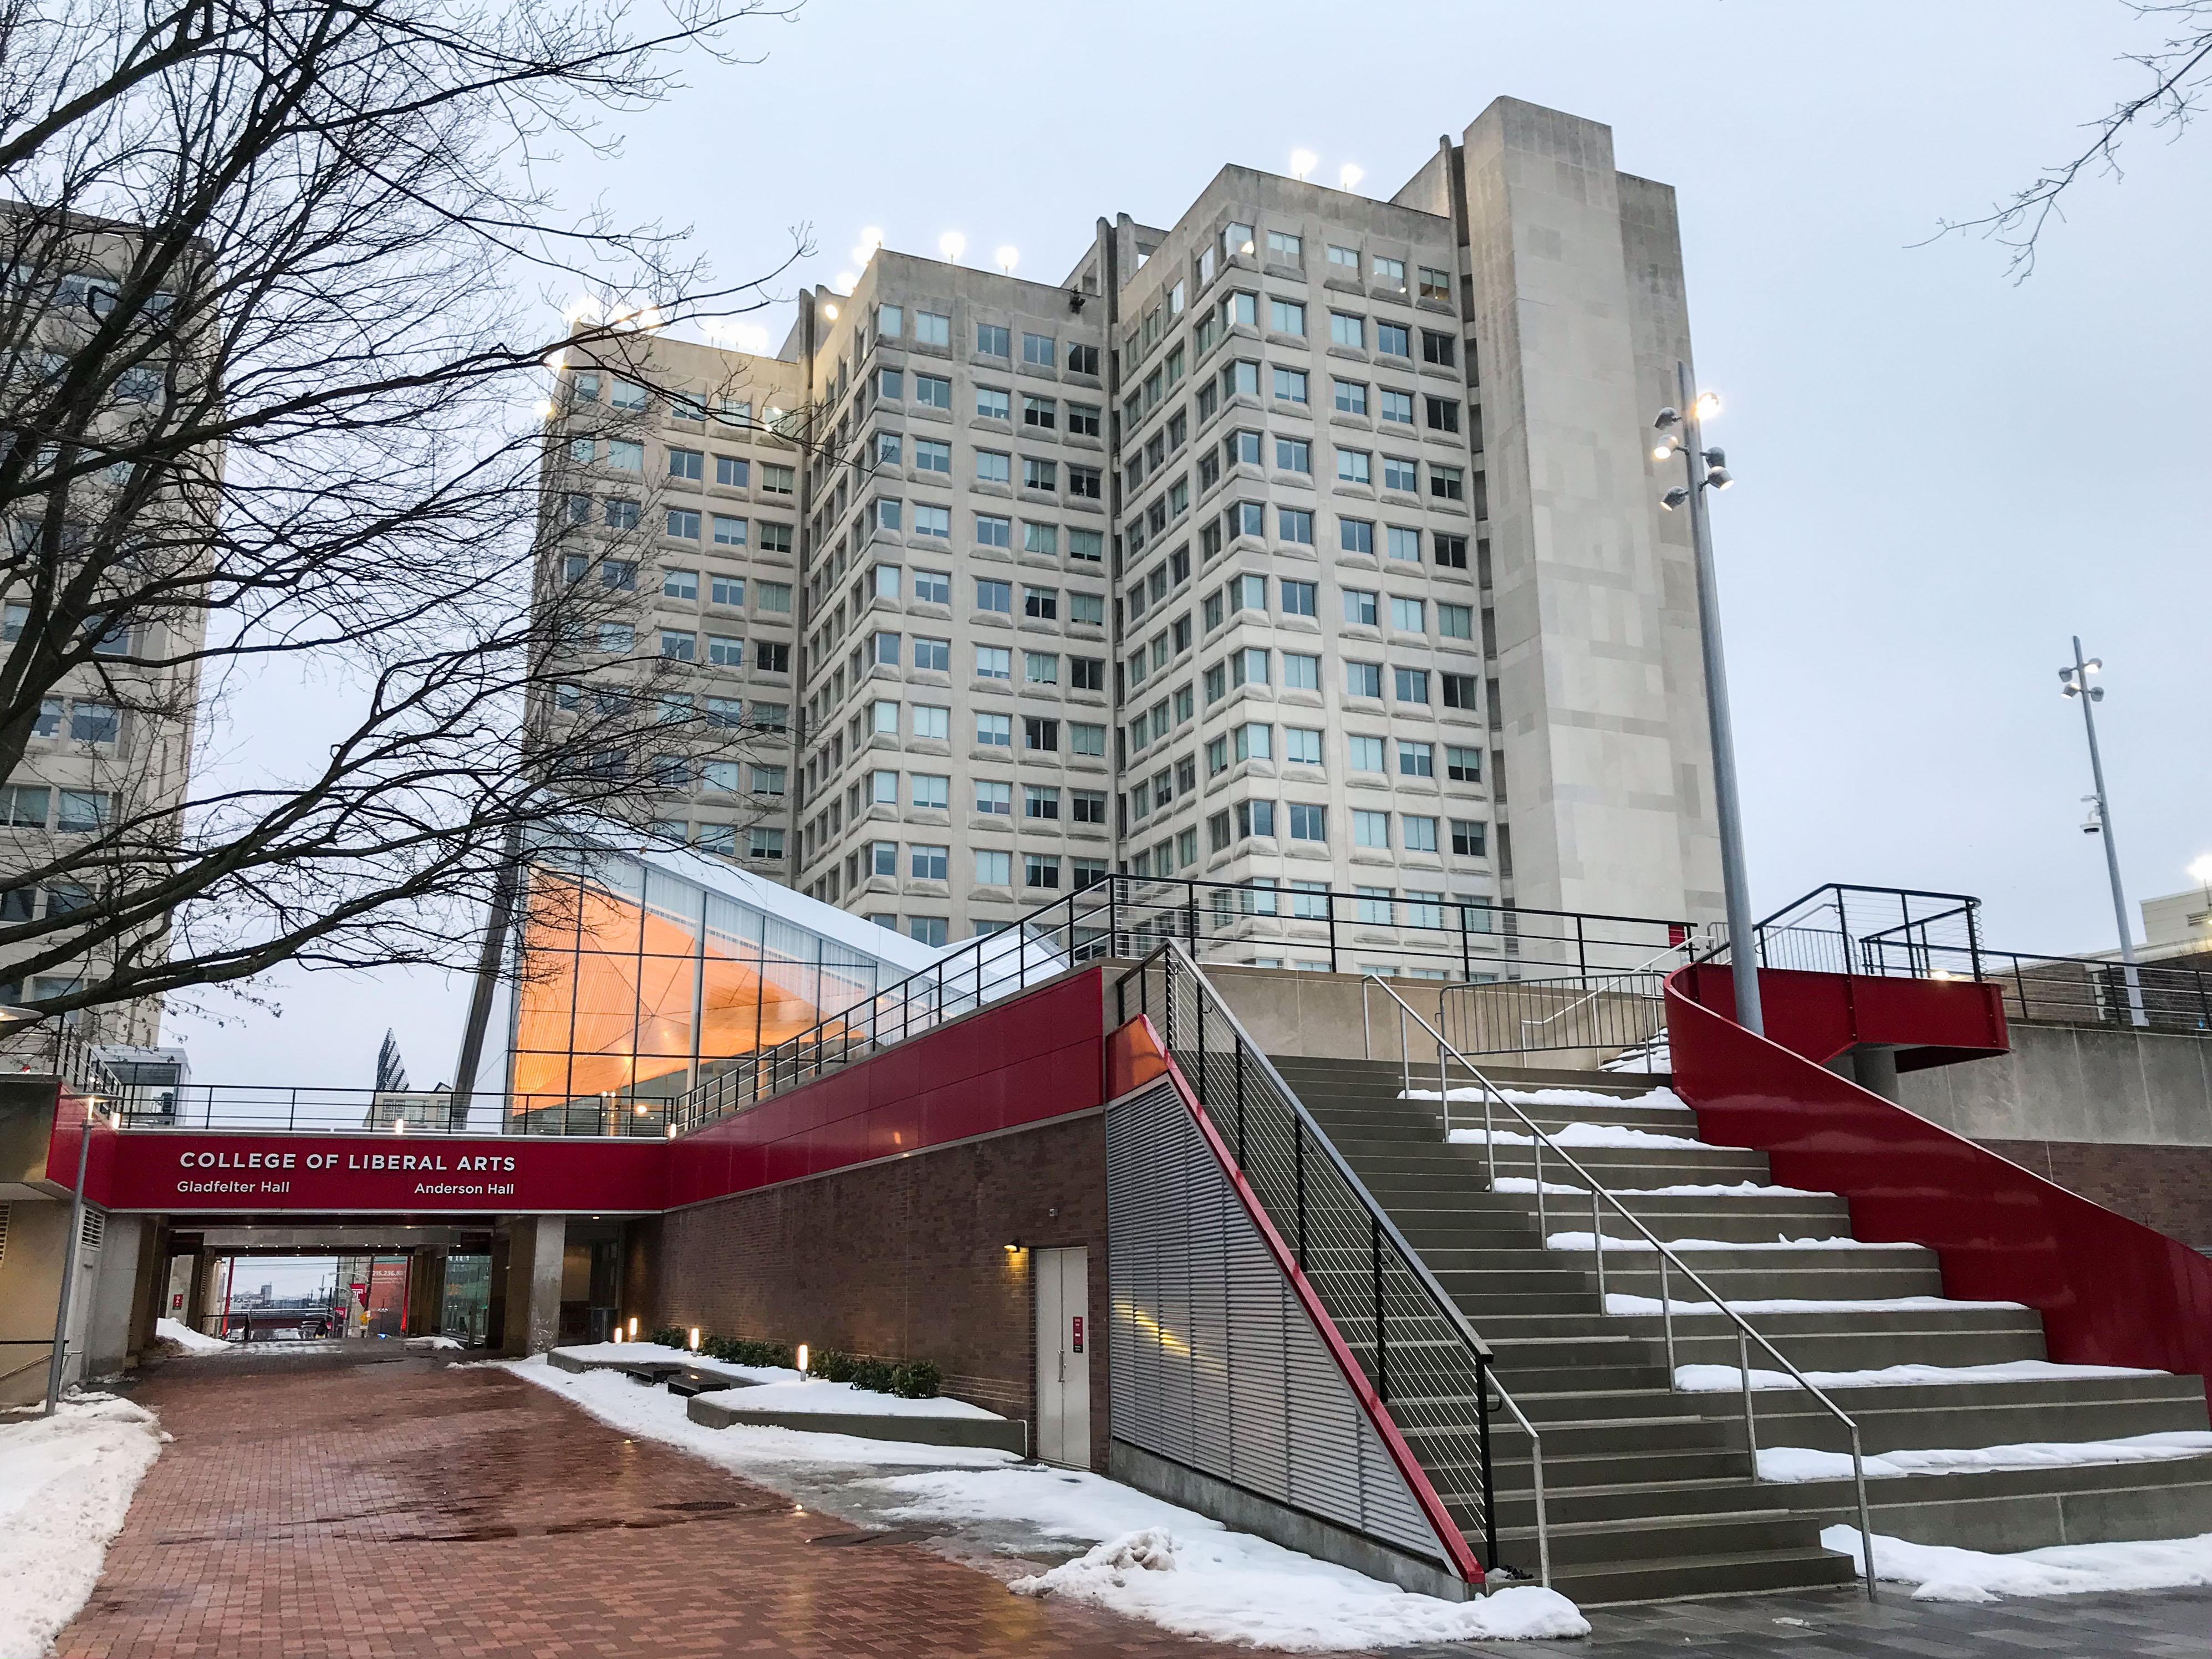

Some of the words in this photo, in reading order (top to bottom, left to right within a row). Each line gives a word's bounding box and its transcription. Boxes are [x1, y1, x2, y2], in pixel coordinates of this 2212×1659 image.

[180, 1152, 296, 1168] COLLEGE
[306, 1153, 339, 1169] OF
[349, 1155, 447, 1171] LIBERAL
[456, 1156, 516, 1171] ARTS
[177, 1181, 256, 1192] Gladfelter
[261, 1181, 290, 1193] Hall
[414, 1182, 483, 1194] Anderson
[487, 1183, 514, 1195] Hall
